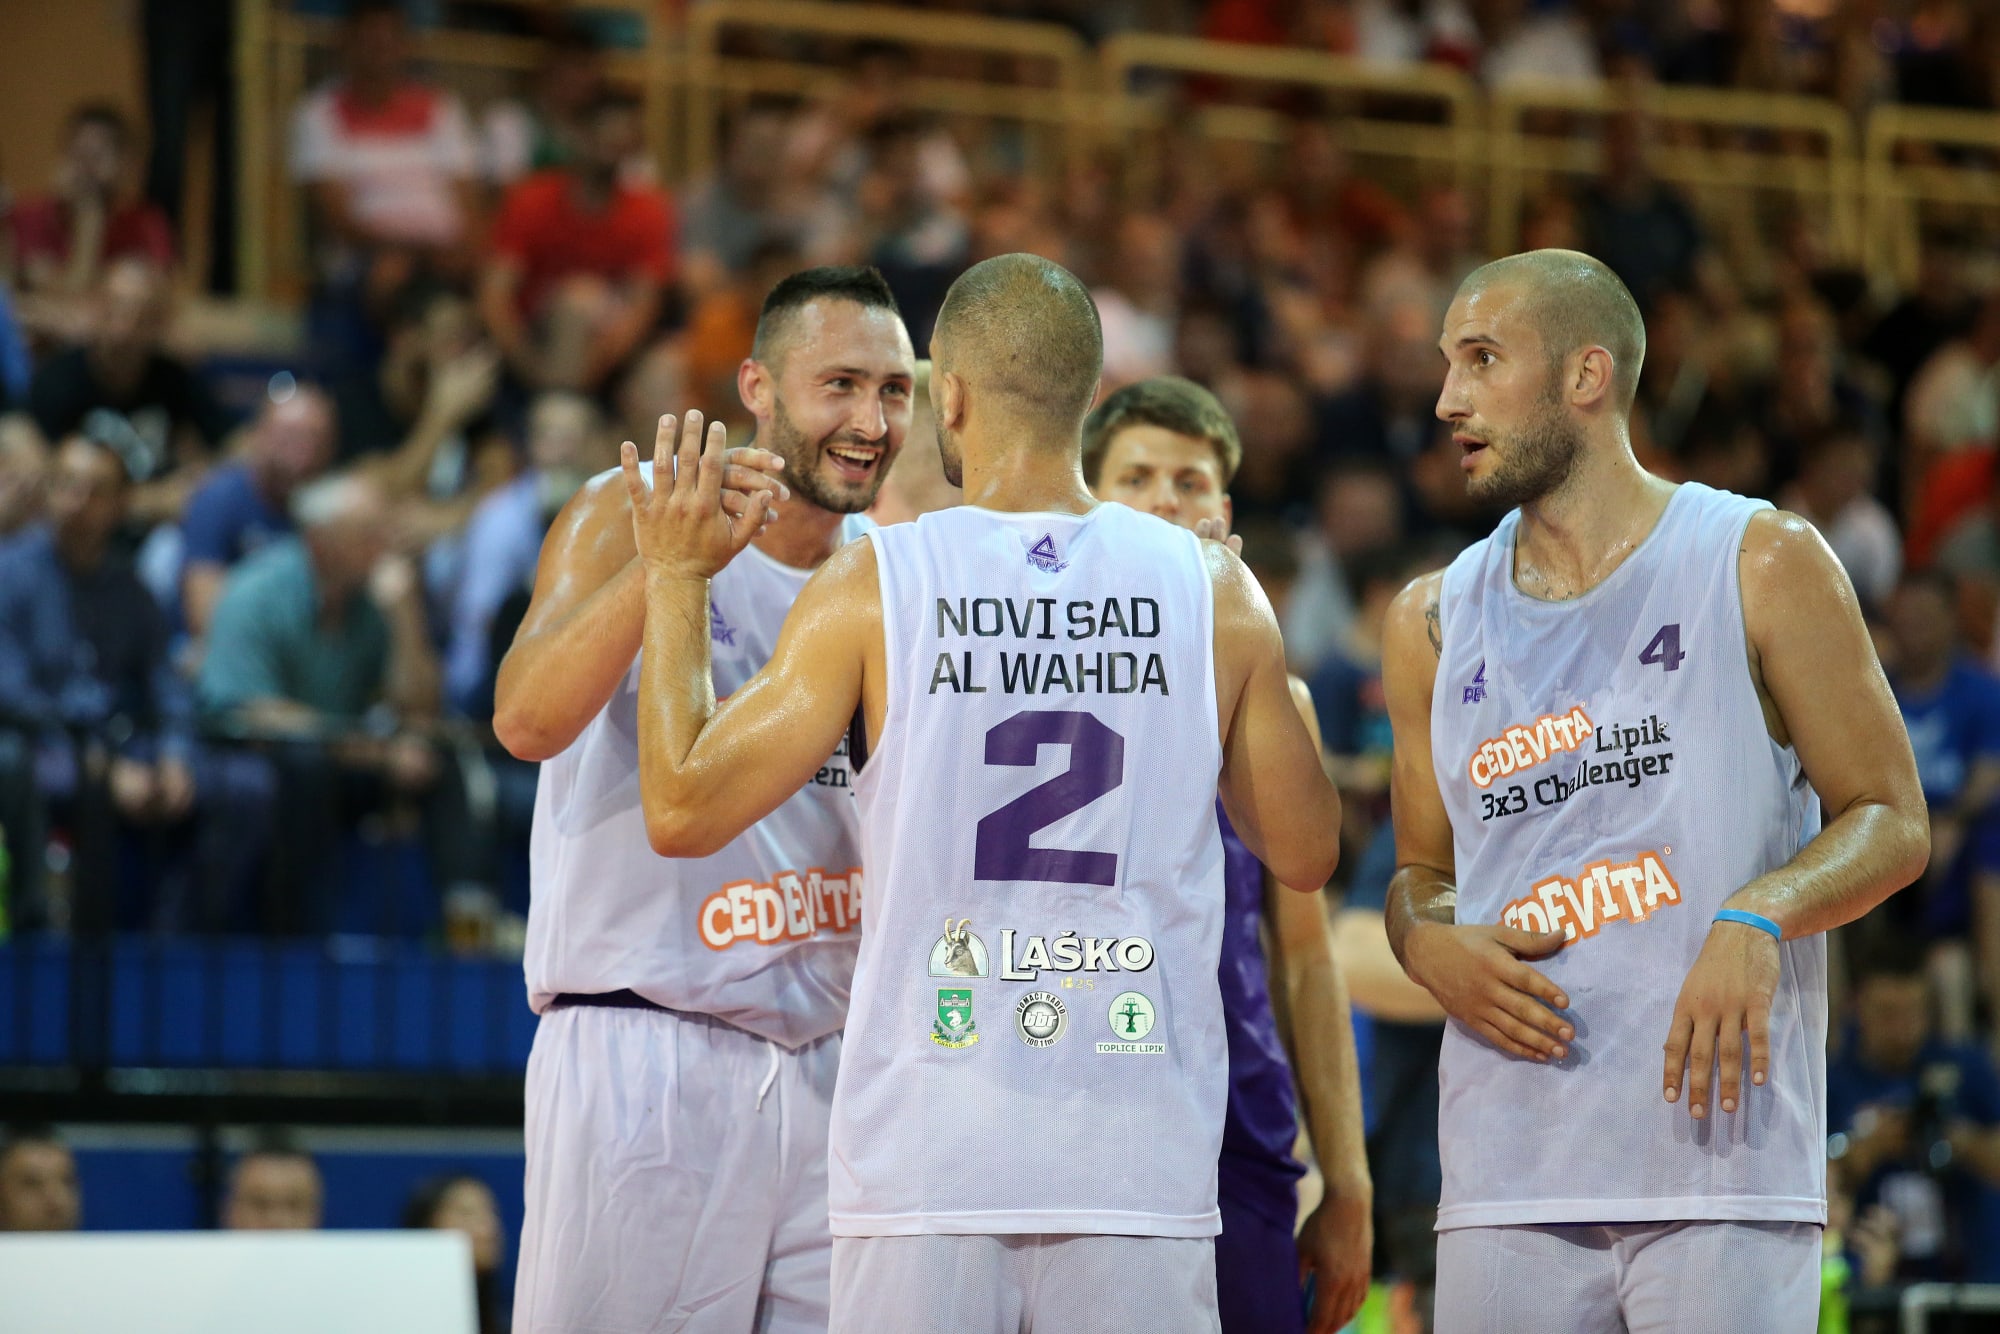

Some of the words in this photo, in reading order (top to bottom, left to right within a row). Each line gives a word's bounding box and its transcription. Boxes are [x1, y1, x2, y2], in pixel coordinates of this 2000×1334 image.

[936, 597, 1057, 639] NOVI
[1066, 597, 1160, 640] SAD
[1638, 624, 1686, 672] 4
[928, 651, 987, 695] AL
[1000, 652, 1170, 696] WAHDA
[1471, 709, 1593, 786] CEDEVITA
[1595, 715, 1671, 756] Lipik
[973, 710, 1125, 887] 2
[1481, 785, 1528, 821] 3x3
[1534, 752, 1674, 807] Challenger
[1000, 929, 1155, 981] LAŠKO
[1016, 992, 1044, 1016] DOMAĆI
[1046, 992, 1067, 1016] RADIO
[1023, 1011, 1058, 1028] bbr
[1098, 1044, 1137, 1053] TOPLICE
[1139, 1044, 1165, 1053] LIPIK
